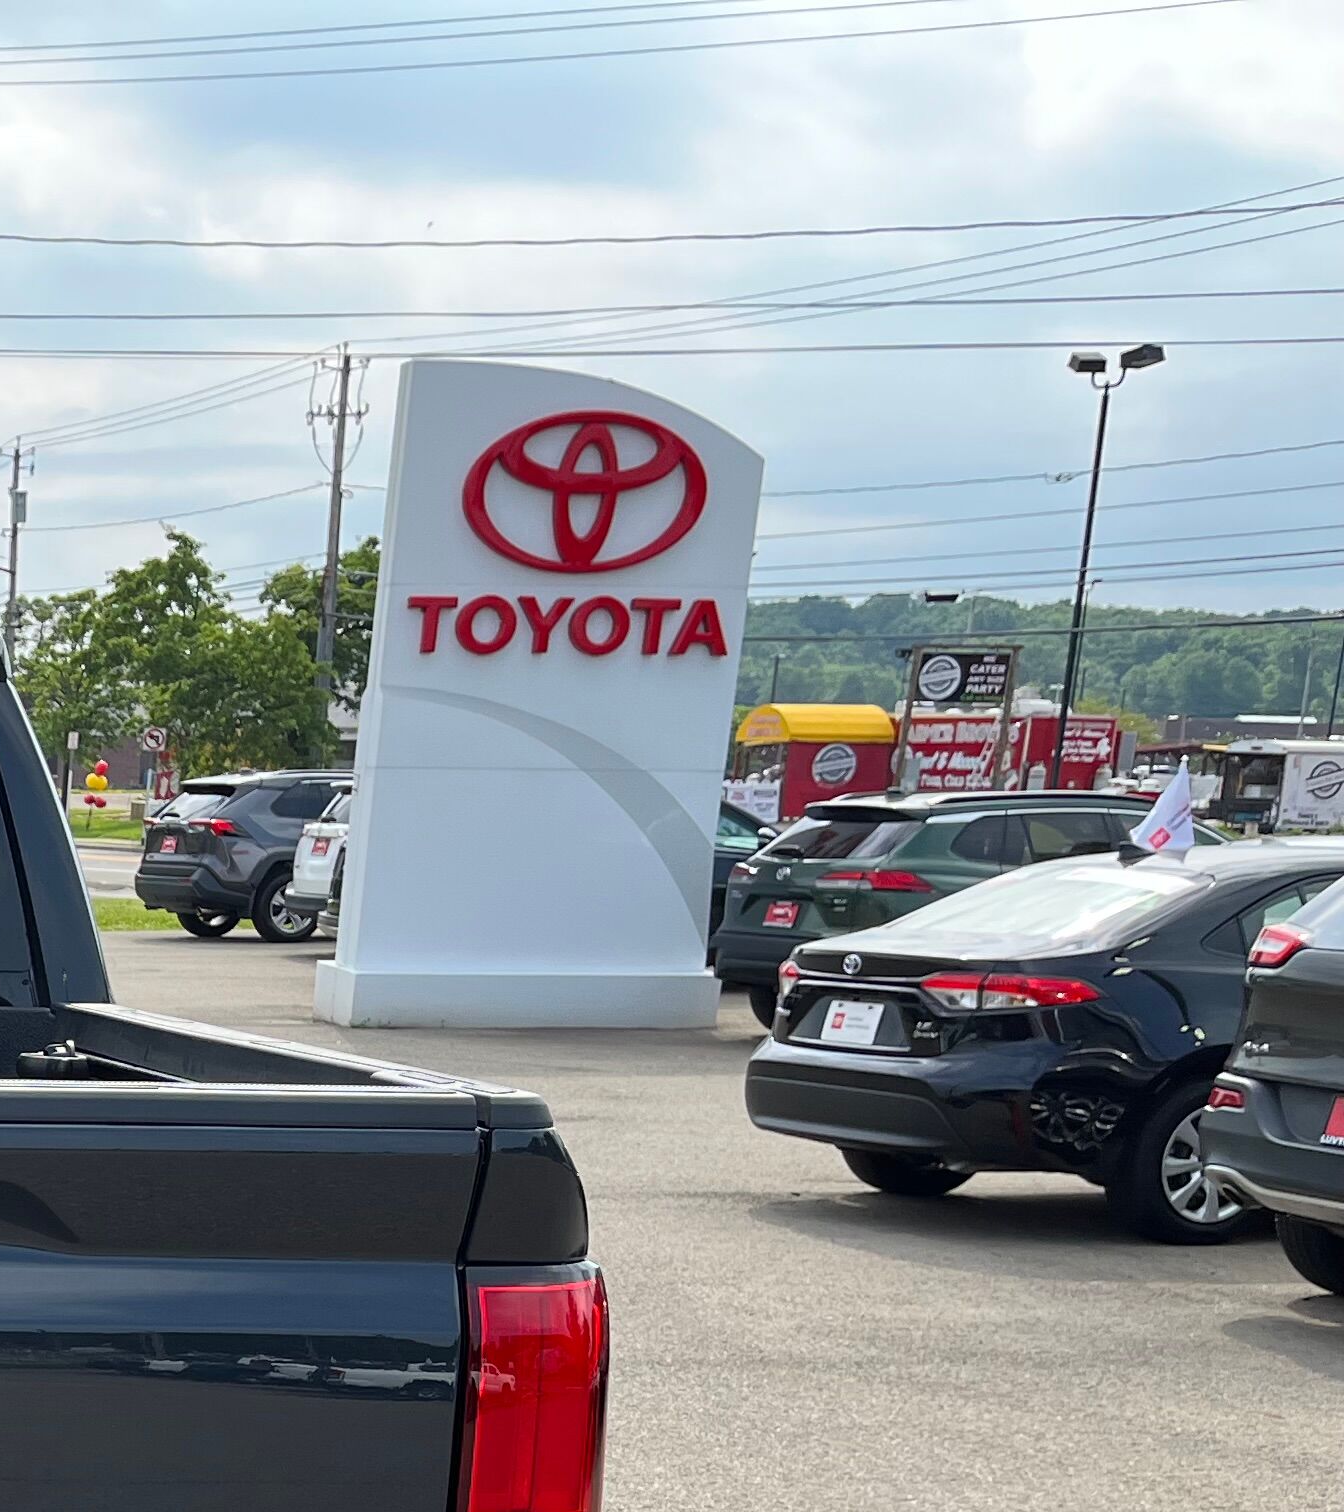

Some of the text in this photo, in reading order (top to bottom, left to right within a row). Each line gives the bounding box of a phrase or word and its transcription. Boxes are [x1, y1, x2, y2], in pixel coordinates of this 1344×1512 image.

[407, 594, 728, 656] TOYOTA
[969, 664, 1007, 674] CATER
[965, 684, 1002, 694] PARTY
